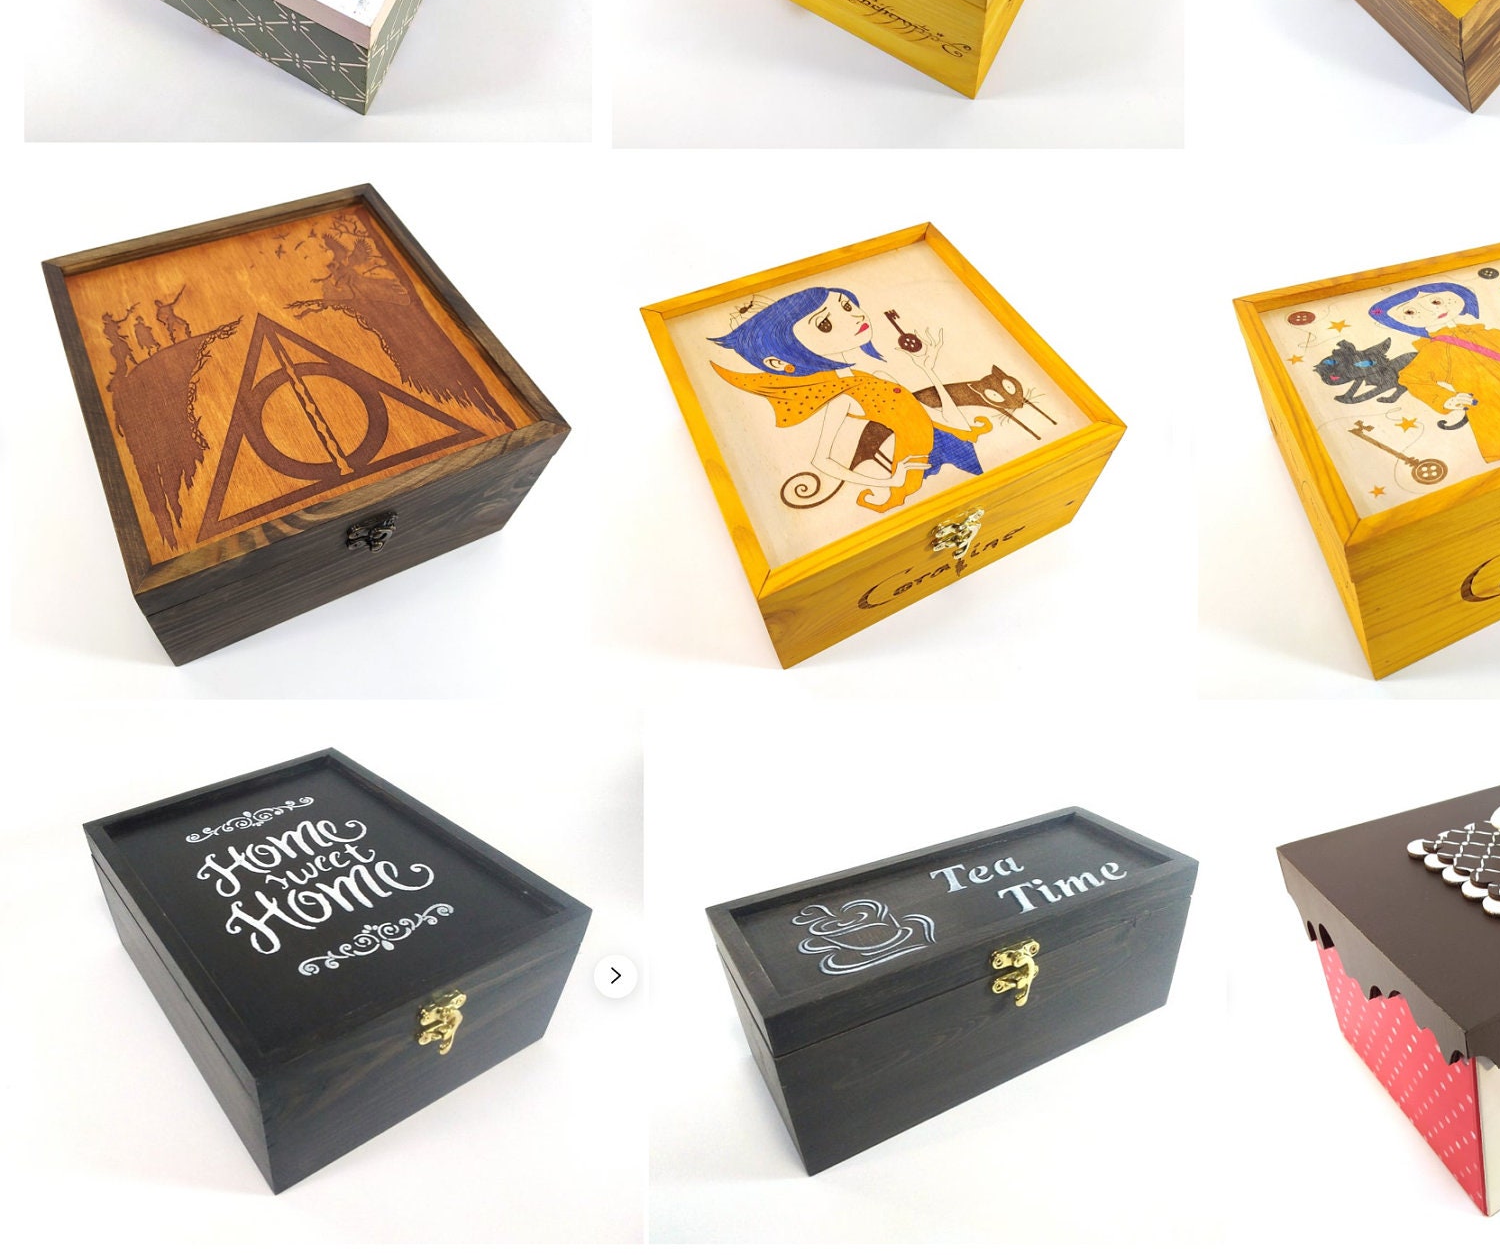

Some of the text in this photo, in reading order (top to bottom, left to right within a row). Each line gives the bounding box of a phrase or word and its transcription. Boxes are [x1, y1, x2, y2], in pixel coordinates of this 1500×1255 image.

[196, 819, 368, 898] Home
[929, 856, 1025, 894] Tea
[996, 861, 1128, 915] Time
[225, 860, 435, 955] Home
